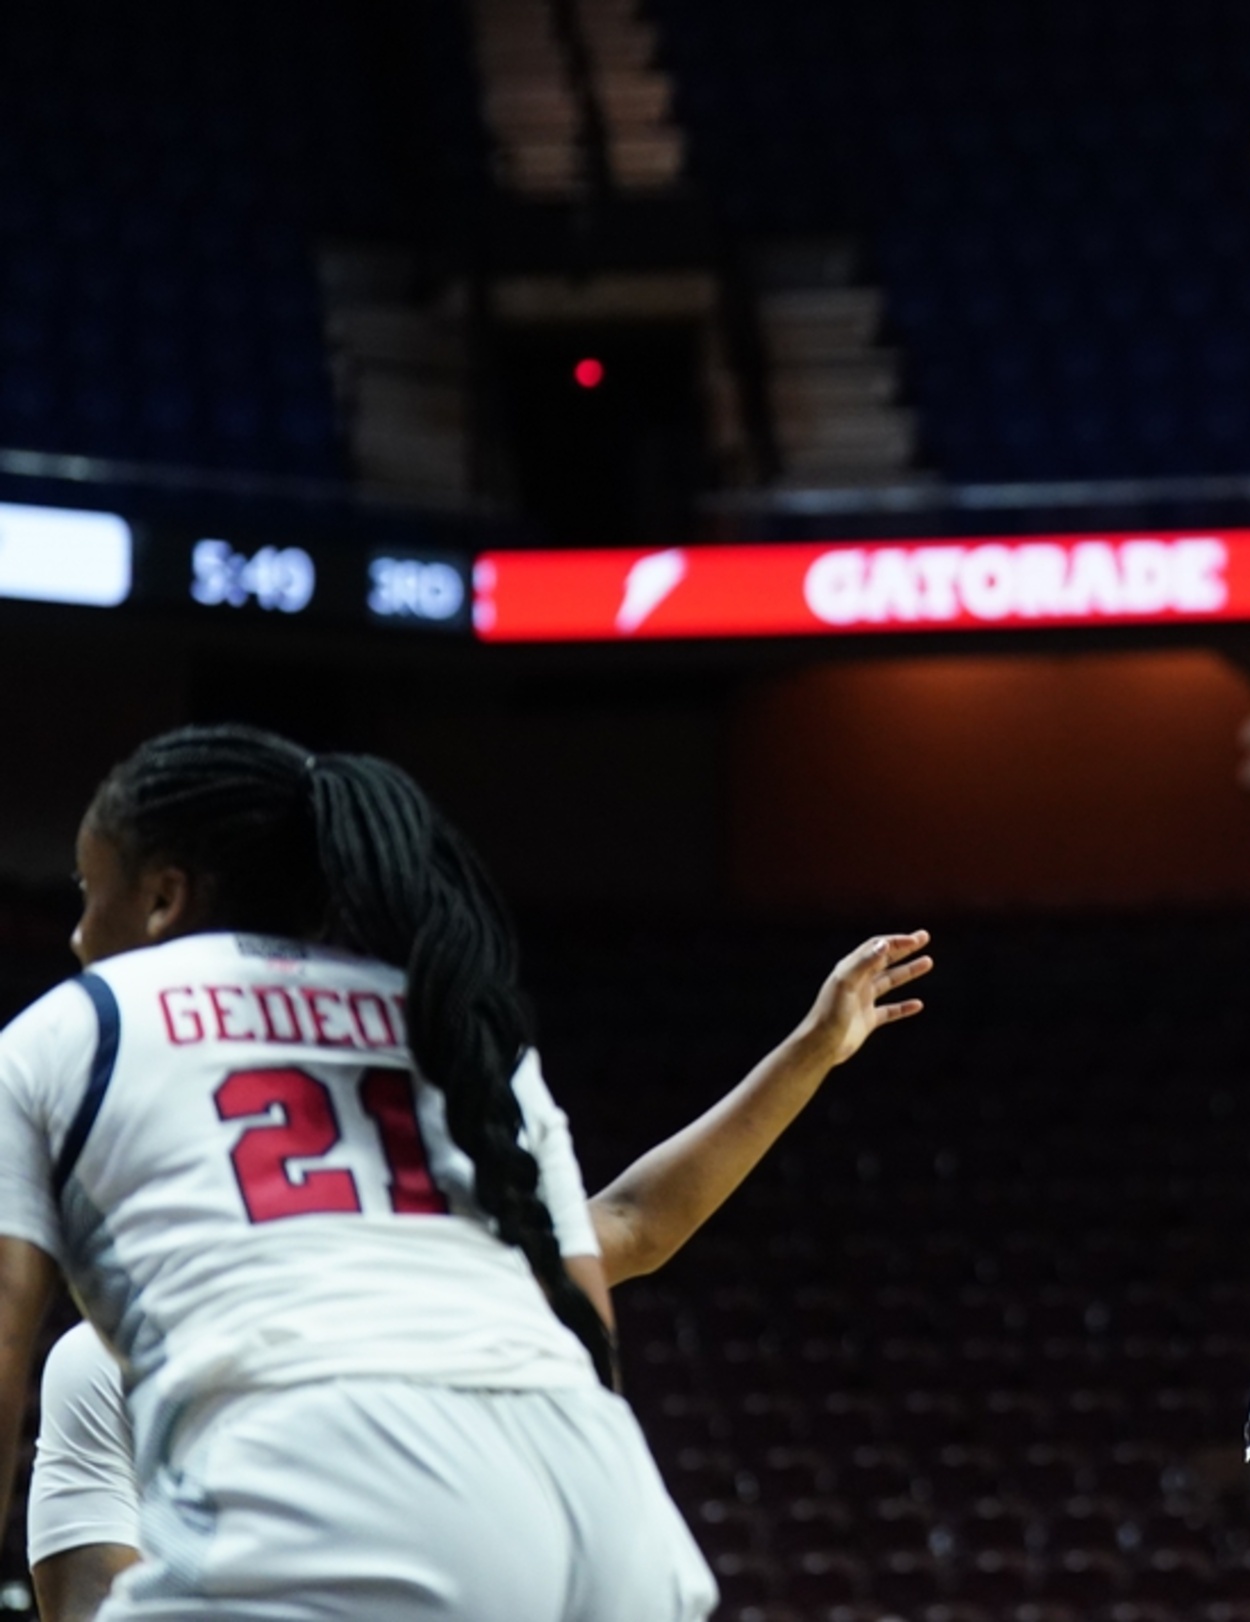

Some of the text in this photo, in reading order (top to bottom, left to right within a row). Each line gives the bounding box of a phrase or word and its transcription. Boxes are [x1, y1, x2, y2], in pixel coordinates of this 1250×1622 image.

[191, 538, 315, 613] 5:49
[367, 556, 465, 619] 3RD
[804, 537, 1229, 625] GATORADE
[157, 984, 408, 1049] GEDEO
[212, 1066, 451, 1226] 21
